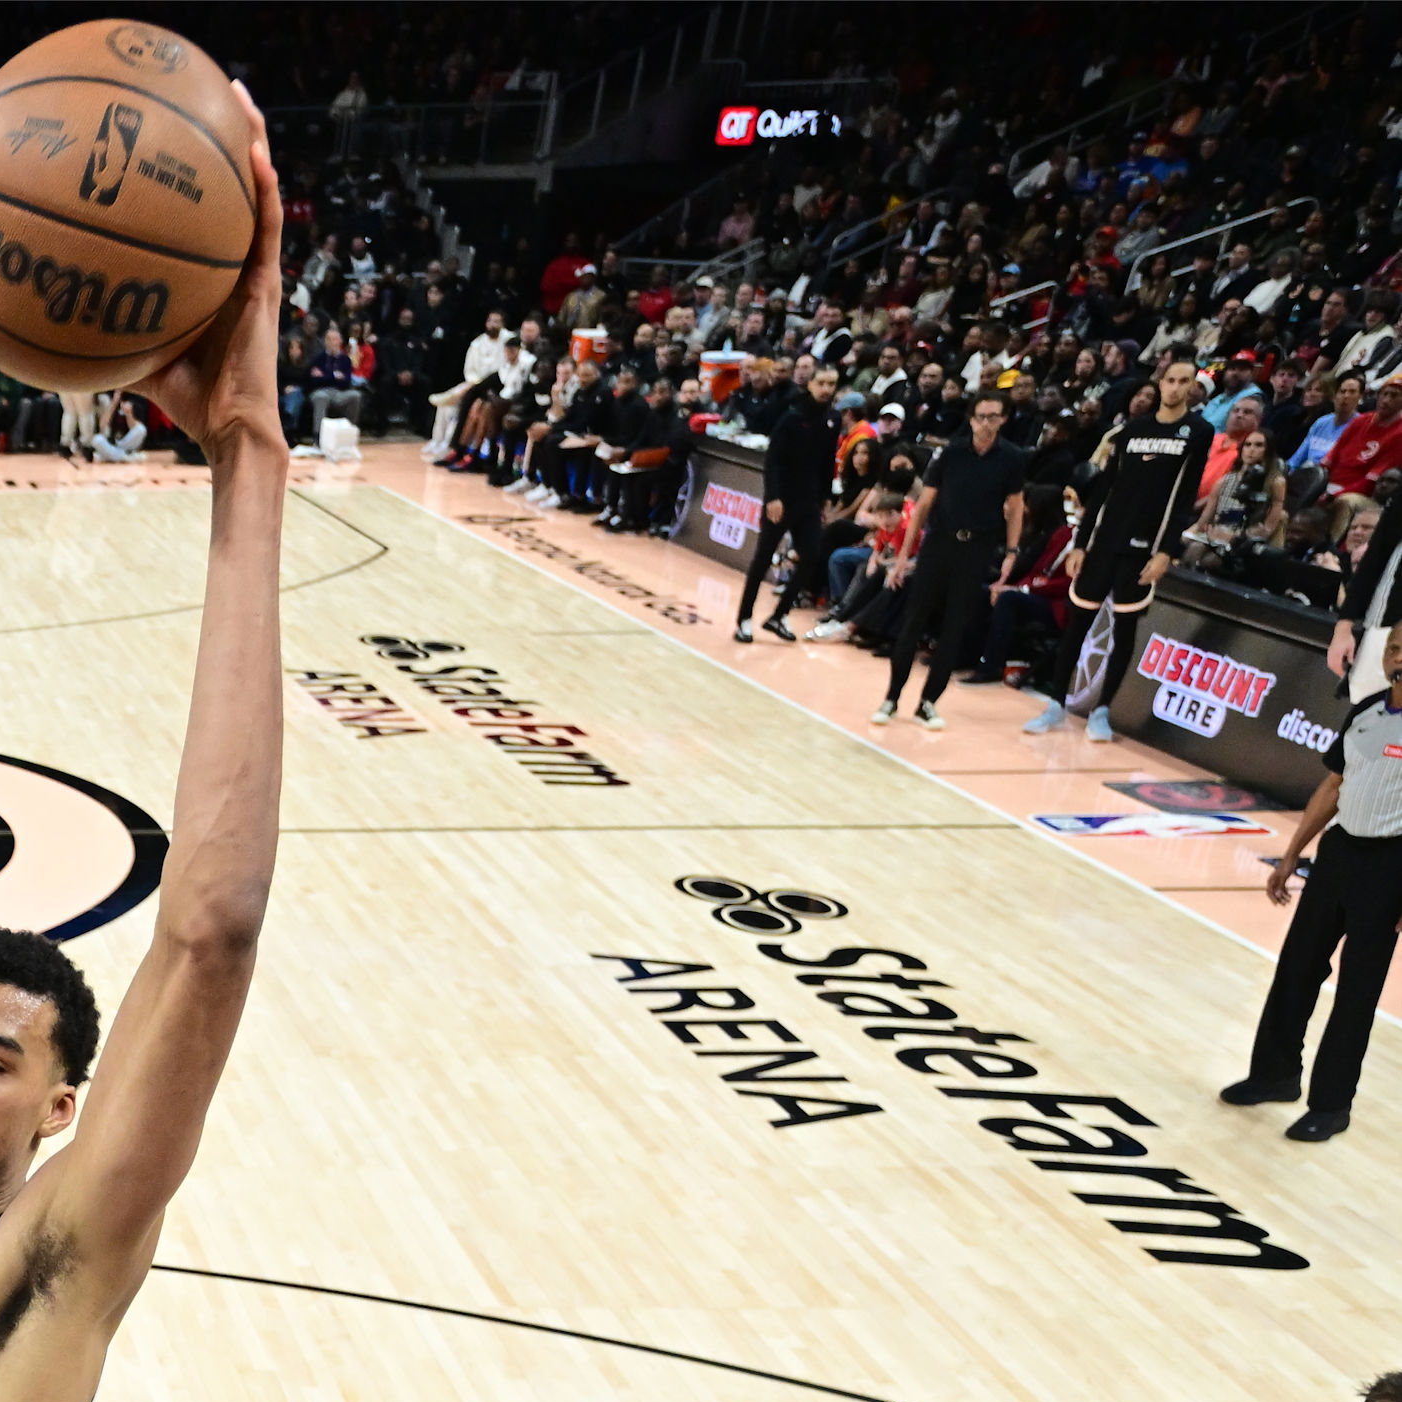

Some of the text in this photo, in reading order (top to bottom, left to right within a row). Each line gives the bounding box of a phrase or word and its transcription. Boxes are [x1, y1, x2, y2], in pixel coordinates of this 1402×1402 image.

[721, 112, 753, 140] QT
[285, 668, 429, 739] ARENA
[1140, 638, 1270, 713] DISCOUNT
[1163, 690, 1216, 728] TIRE
[590, 952, 885, 1129] ARENA
